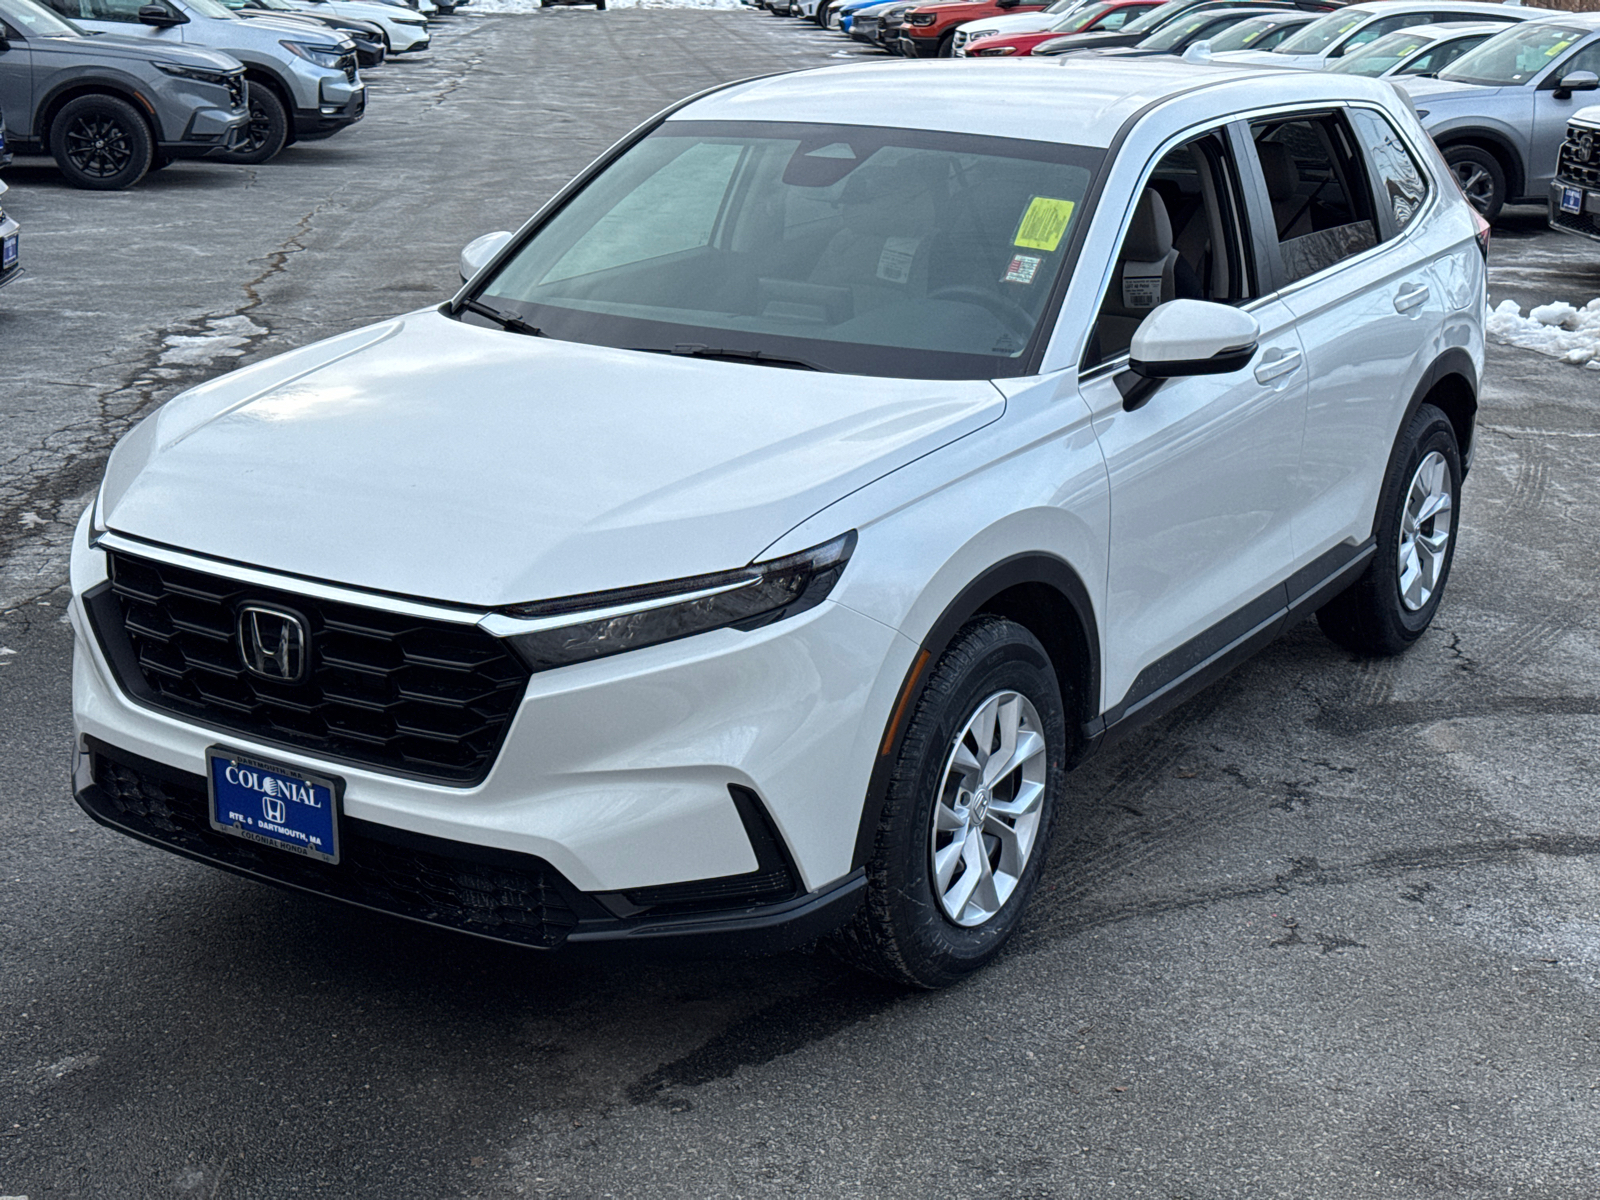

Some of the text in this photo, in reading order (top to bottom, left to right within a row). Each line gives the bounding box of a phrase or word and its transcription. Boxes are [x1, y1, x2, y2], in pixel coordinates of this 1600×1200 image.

[225, 766, 321, 808] COLONIAL
[229, 811, 246, 823] RTE.
[247, 816, 253, 825] 6
[309, 835, 322, 846] MA
[241, 830, 308, 856] COLONIAL HONDA
